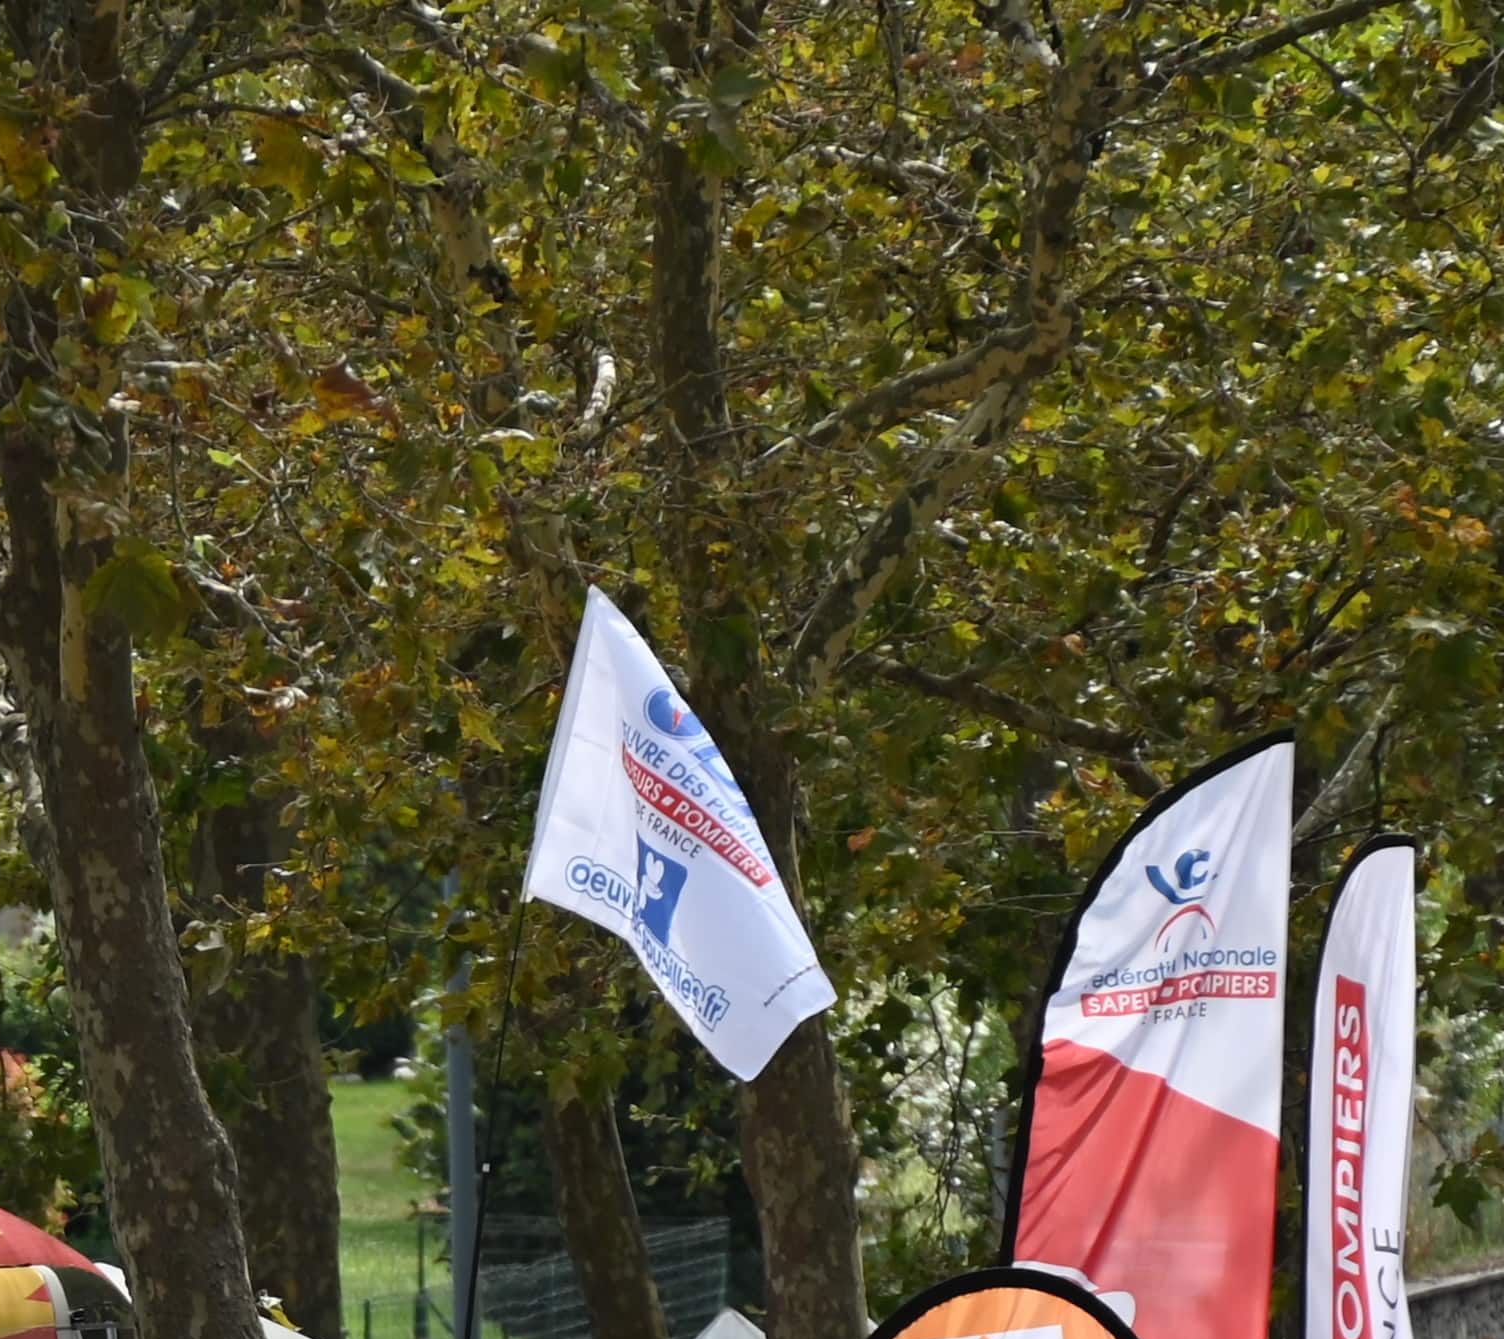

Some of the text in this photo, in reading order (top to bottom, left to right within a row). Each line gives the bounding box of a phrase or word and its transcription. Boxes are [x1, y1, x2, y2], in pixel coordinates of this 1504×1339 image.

[667, 760, 708, 799] DES
[647, 812, 702, 860] FRANCE
[674, 802, 765, 881] POMPIERS
